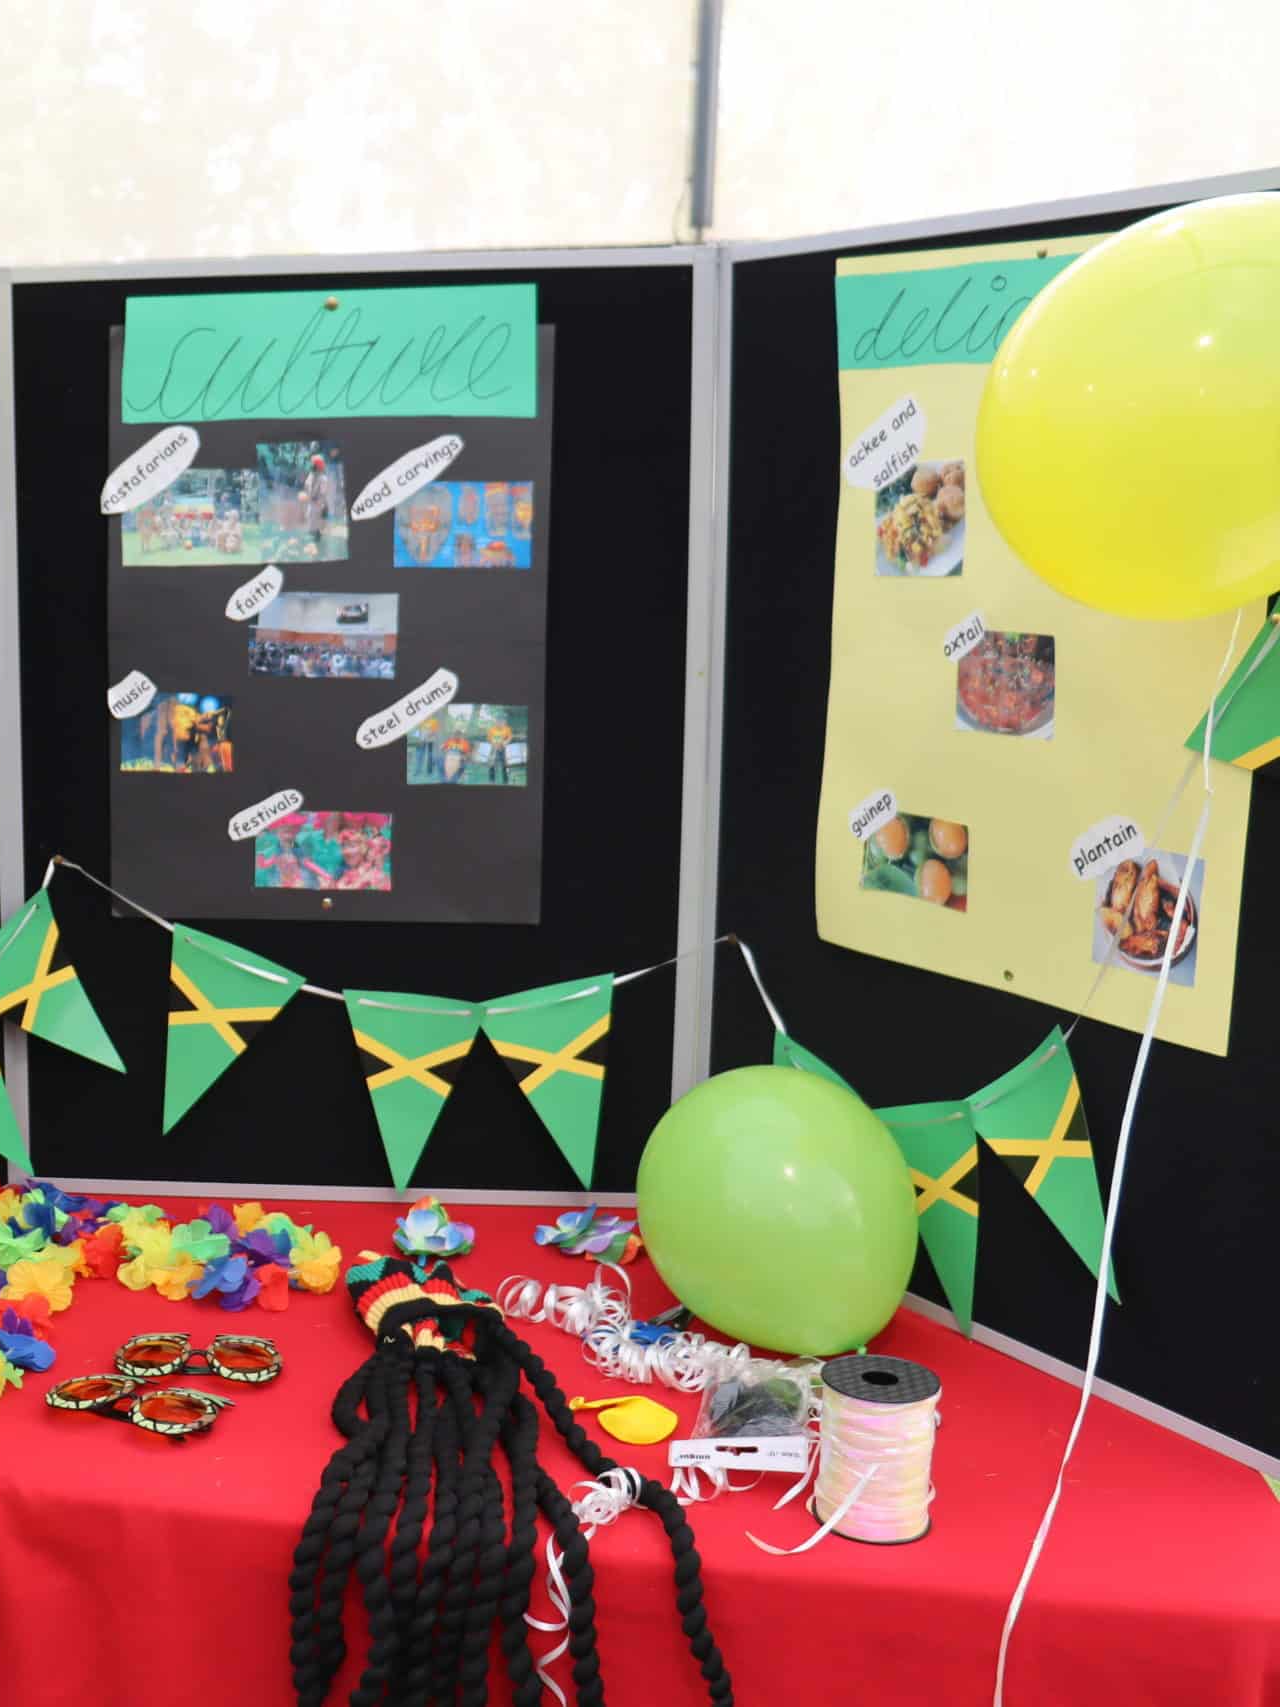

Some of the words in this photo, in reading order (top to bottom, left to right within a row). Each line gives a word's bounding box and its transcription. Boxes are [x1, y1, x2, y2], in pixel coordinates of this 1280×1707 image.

[848, 429, 888, 467] ackee
[891, 399, 917, 430] and
[103, 432, 189, 512] rastafarians
[352, 482, 392, 515] wood
[396, 439, 460, 488] carvings
[234, 580, 275, 616] faith
[943, 615, 985, 657] oxtail
[111, 679, 152, 715] music
[361, 714, 401, 746] steel
[405, 680, 453, 717] drums
[232, 791, 300, 838] festivals
[851, 793, 894, 837] guinep
[1072, 824, 1138, 876] plantain
